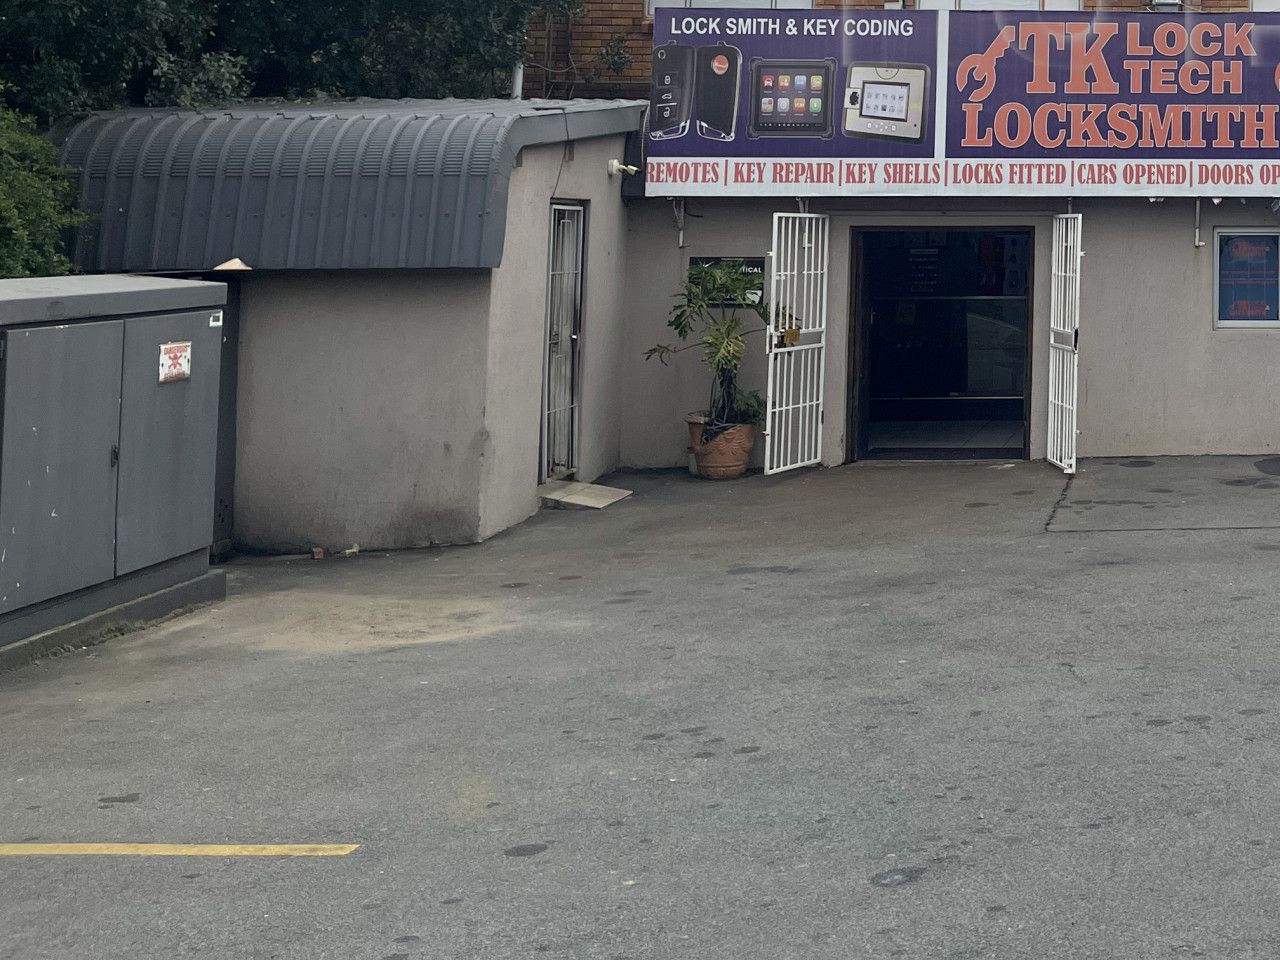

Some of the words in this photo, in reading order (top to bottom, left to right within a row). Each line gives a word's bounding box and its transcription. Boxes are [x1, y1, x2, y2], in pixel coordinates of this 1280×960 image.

[671, 17, 721, 35] LOCK
[725, 17, 780, 36] SMITH
[785, 18, 799, 36] &
[803, 18, 840, 36] KEY
[844, 19, 914, 37] CODING
[1127, 22, 1257, 57] LOCK
[1019, 21, 1120, 95] TK
[1123, 60, 1243, 95] TECH
[961, 102, 1279, 150] LOCKSMITH
[645, 162, 720, 184] REMOTES
[733, 162, 765, 184] KEY
[771, 162, 834, 184] REPAIR
[845, 162, 878, 184] KEY
[883, 162, 940, 184] SHELLS
[951, 163, 1003, 185] LOCKS
[1008, 163, 1067, 185] FITTED
[1076, 164, 1117, 185] CARS
[1122, 164, 1187, 185] OPENED
[1197, 164, 1254, 185] DOORS
